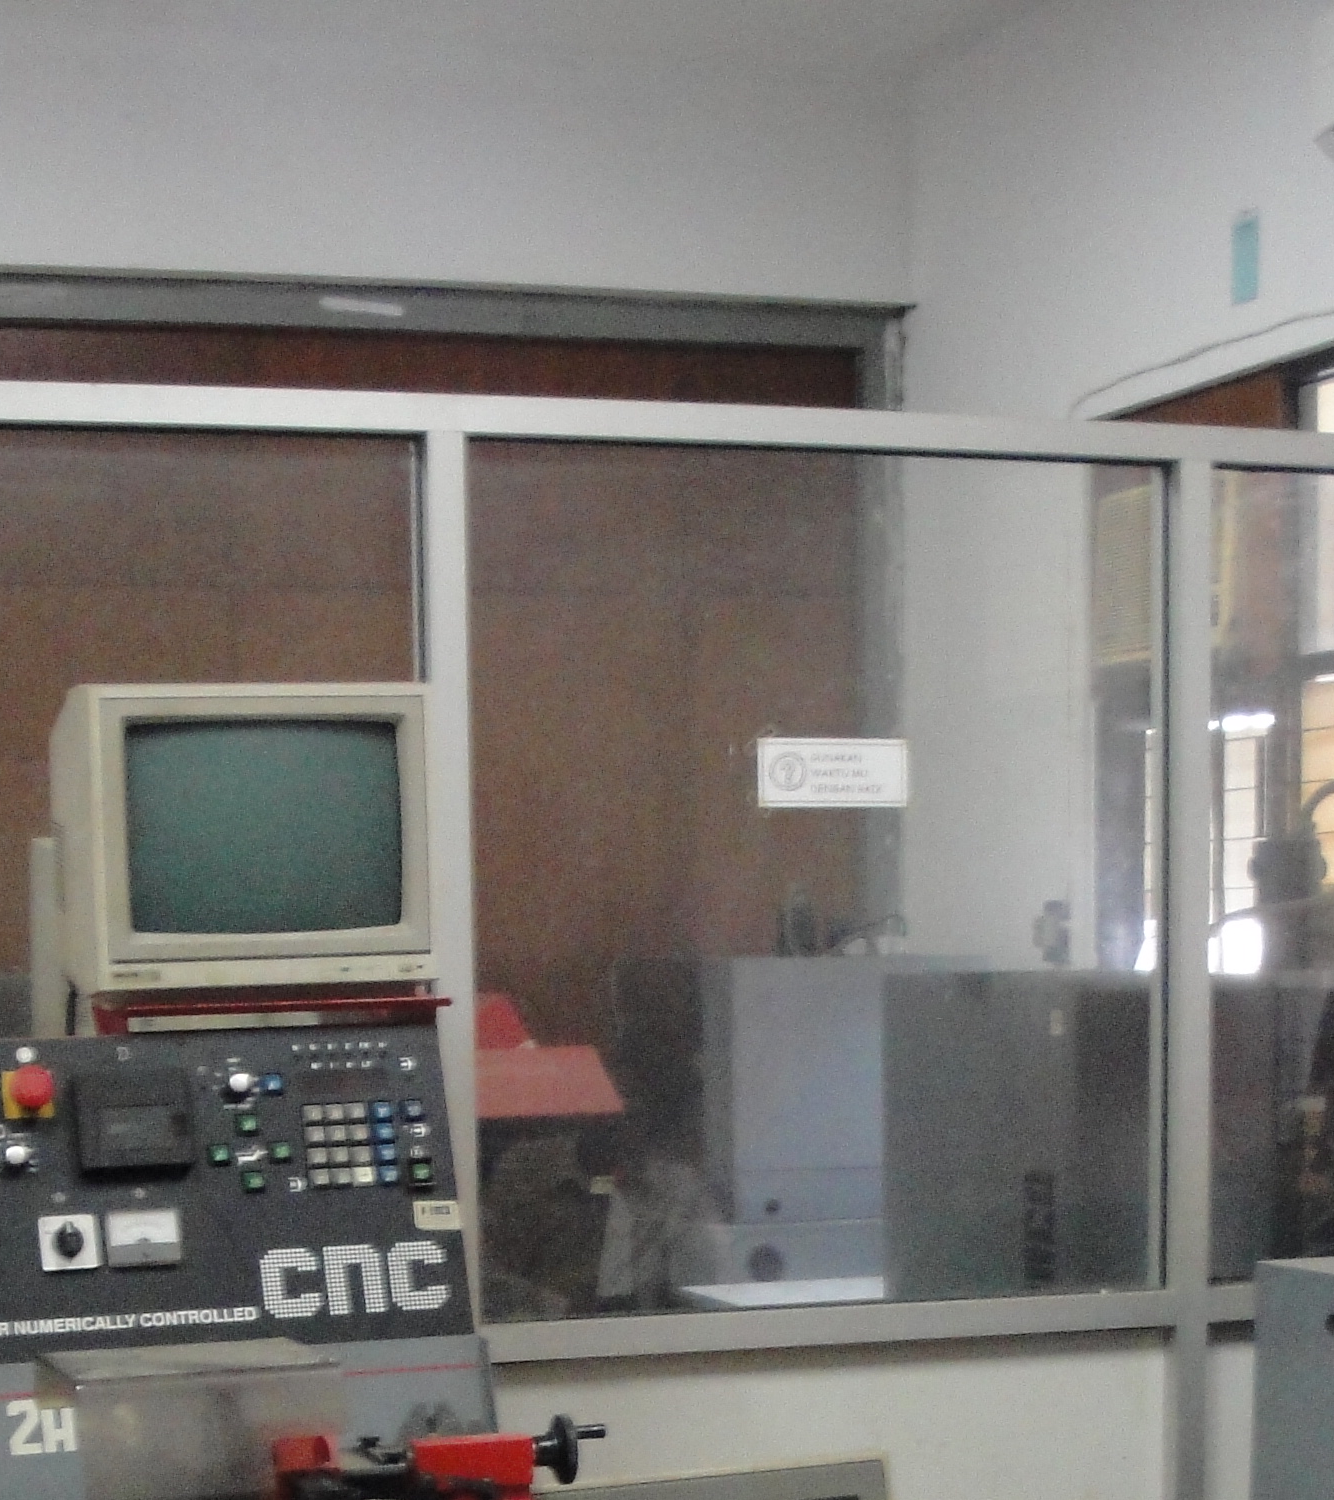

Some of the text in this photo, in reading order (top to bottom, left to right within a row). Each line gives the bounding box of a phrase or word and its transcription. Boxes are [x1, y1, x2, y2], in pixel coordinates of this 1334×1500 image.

[13, 1313, 136, 1336] NUMERICALLY
[139, 1305, 260, 1328] CONTROLLED
[5, 1398, 79, 1456] 2H
